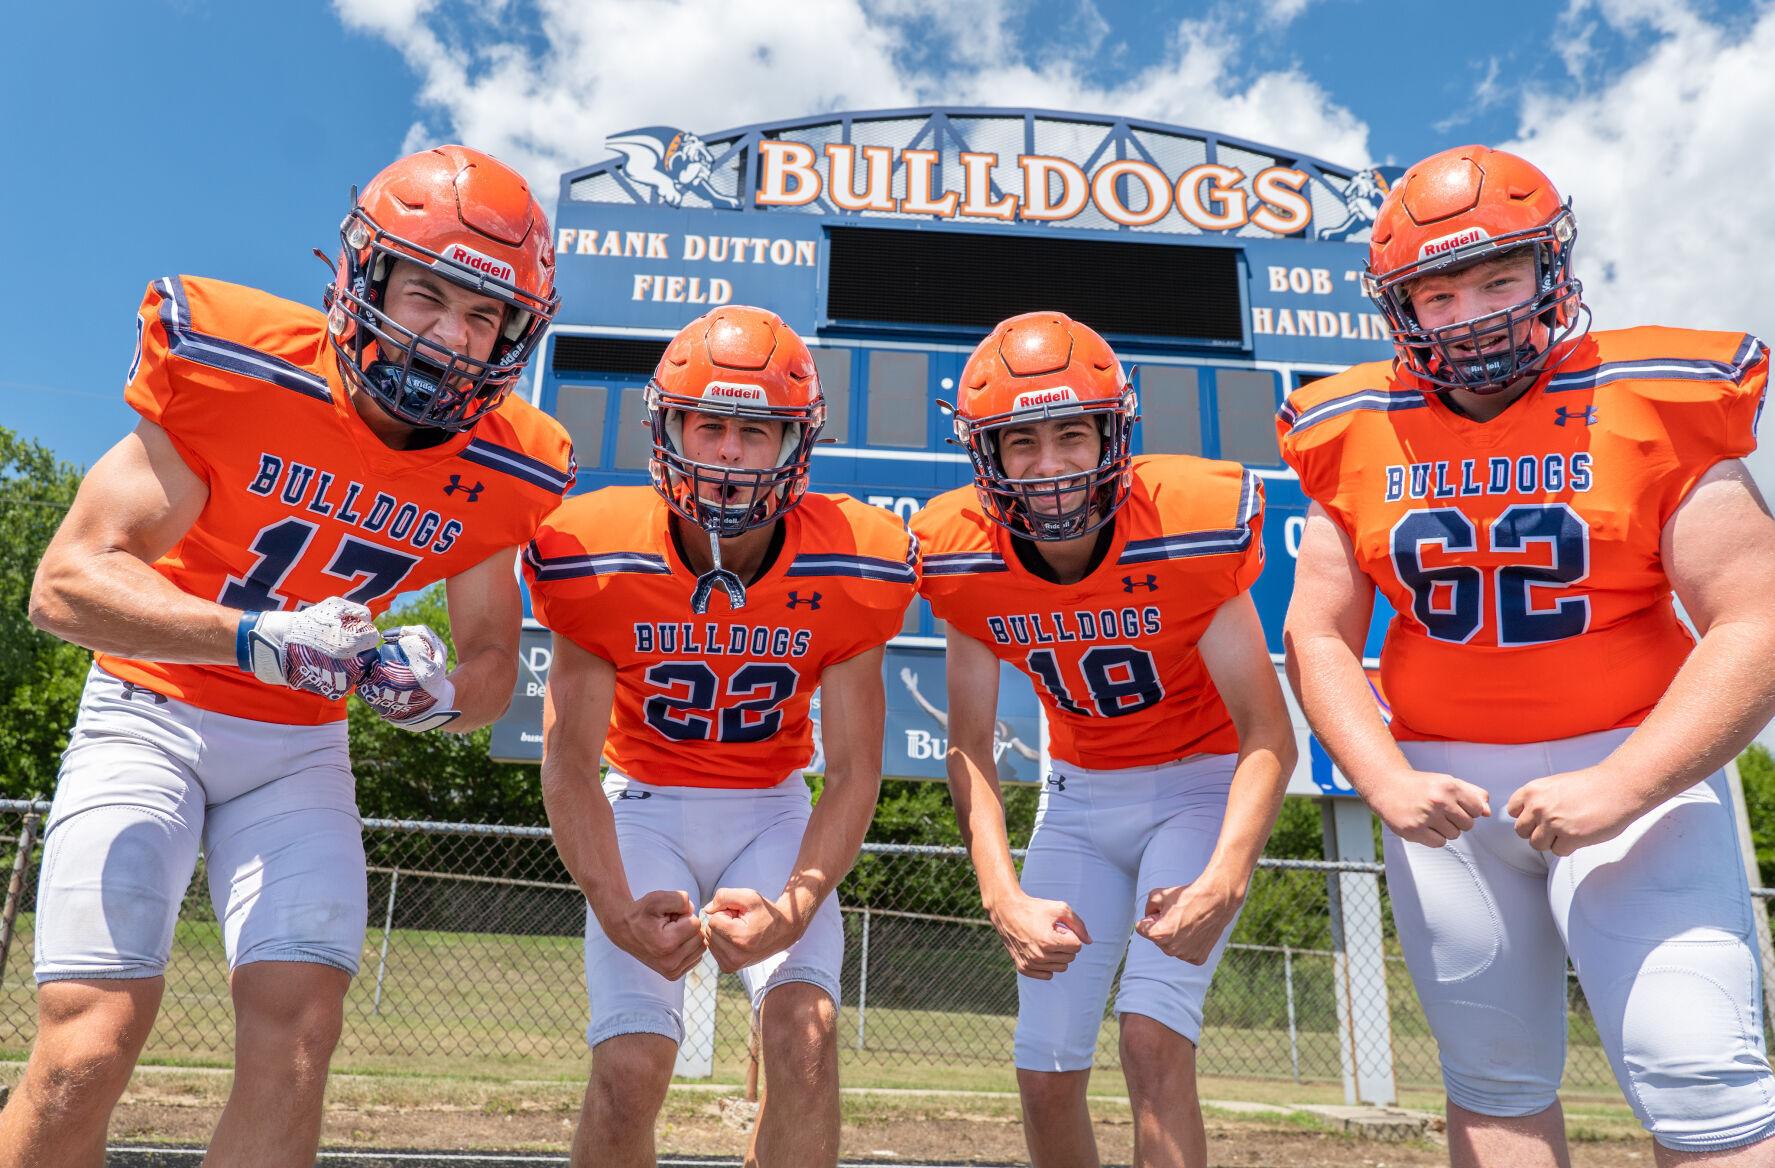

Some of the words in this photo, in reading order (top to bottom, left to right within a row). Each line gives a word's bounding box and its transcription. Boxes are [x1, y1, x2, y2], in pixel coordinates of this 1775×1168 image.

[756, 140, 1312, 234] BULLDOGS
[557, 228, 669, 260] FRANK
[682, 234, 817, 267] DUTTON
[1424, 230, 1480, 256] Riddell
[452, 246, 511, 281] Riddell
[1268, 266, 1333, 295] BOB
[631, 274, 734, 305] FIELD
[711, 385, 760, 399] Riddell
[1020, 389, 1070, 407] Riddell
[1385, 451, 1594, 502] BULLDOGS
[246, 452, 464, 556] BULLDOGS
[216, 516, 423, 612] 17
[1389, 503, 1592, 647] 62
[633, 622, 812, 657] BULLDOGS
[986, 606, 1162, 645] BULLDOGS
[644, 660, 800, 742] 22
[1025, 645, 1166, 718] 18
